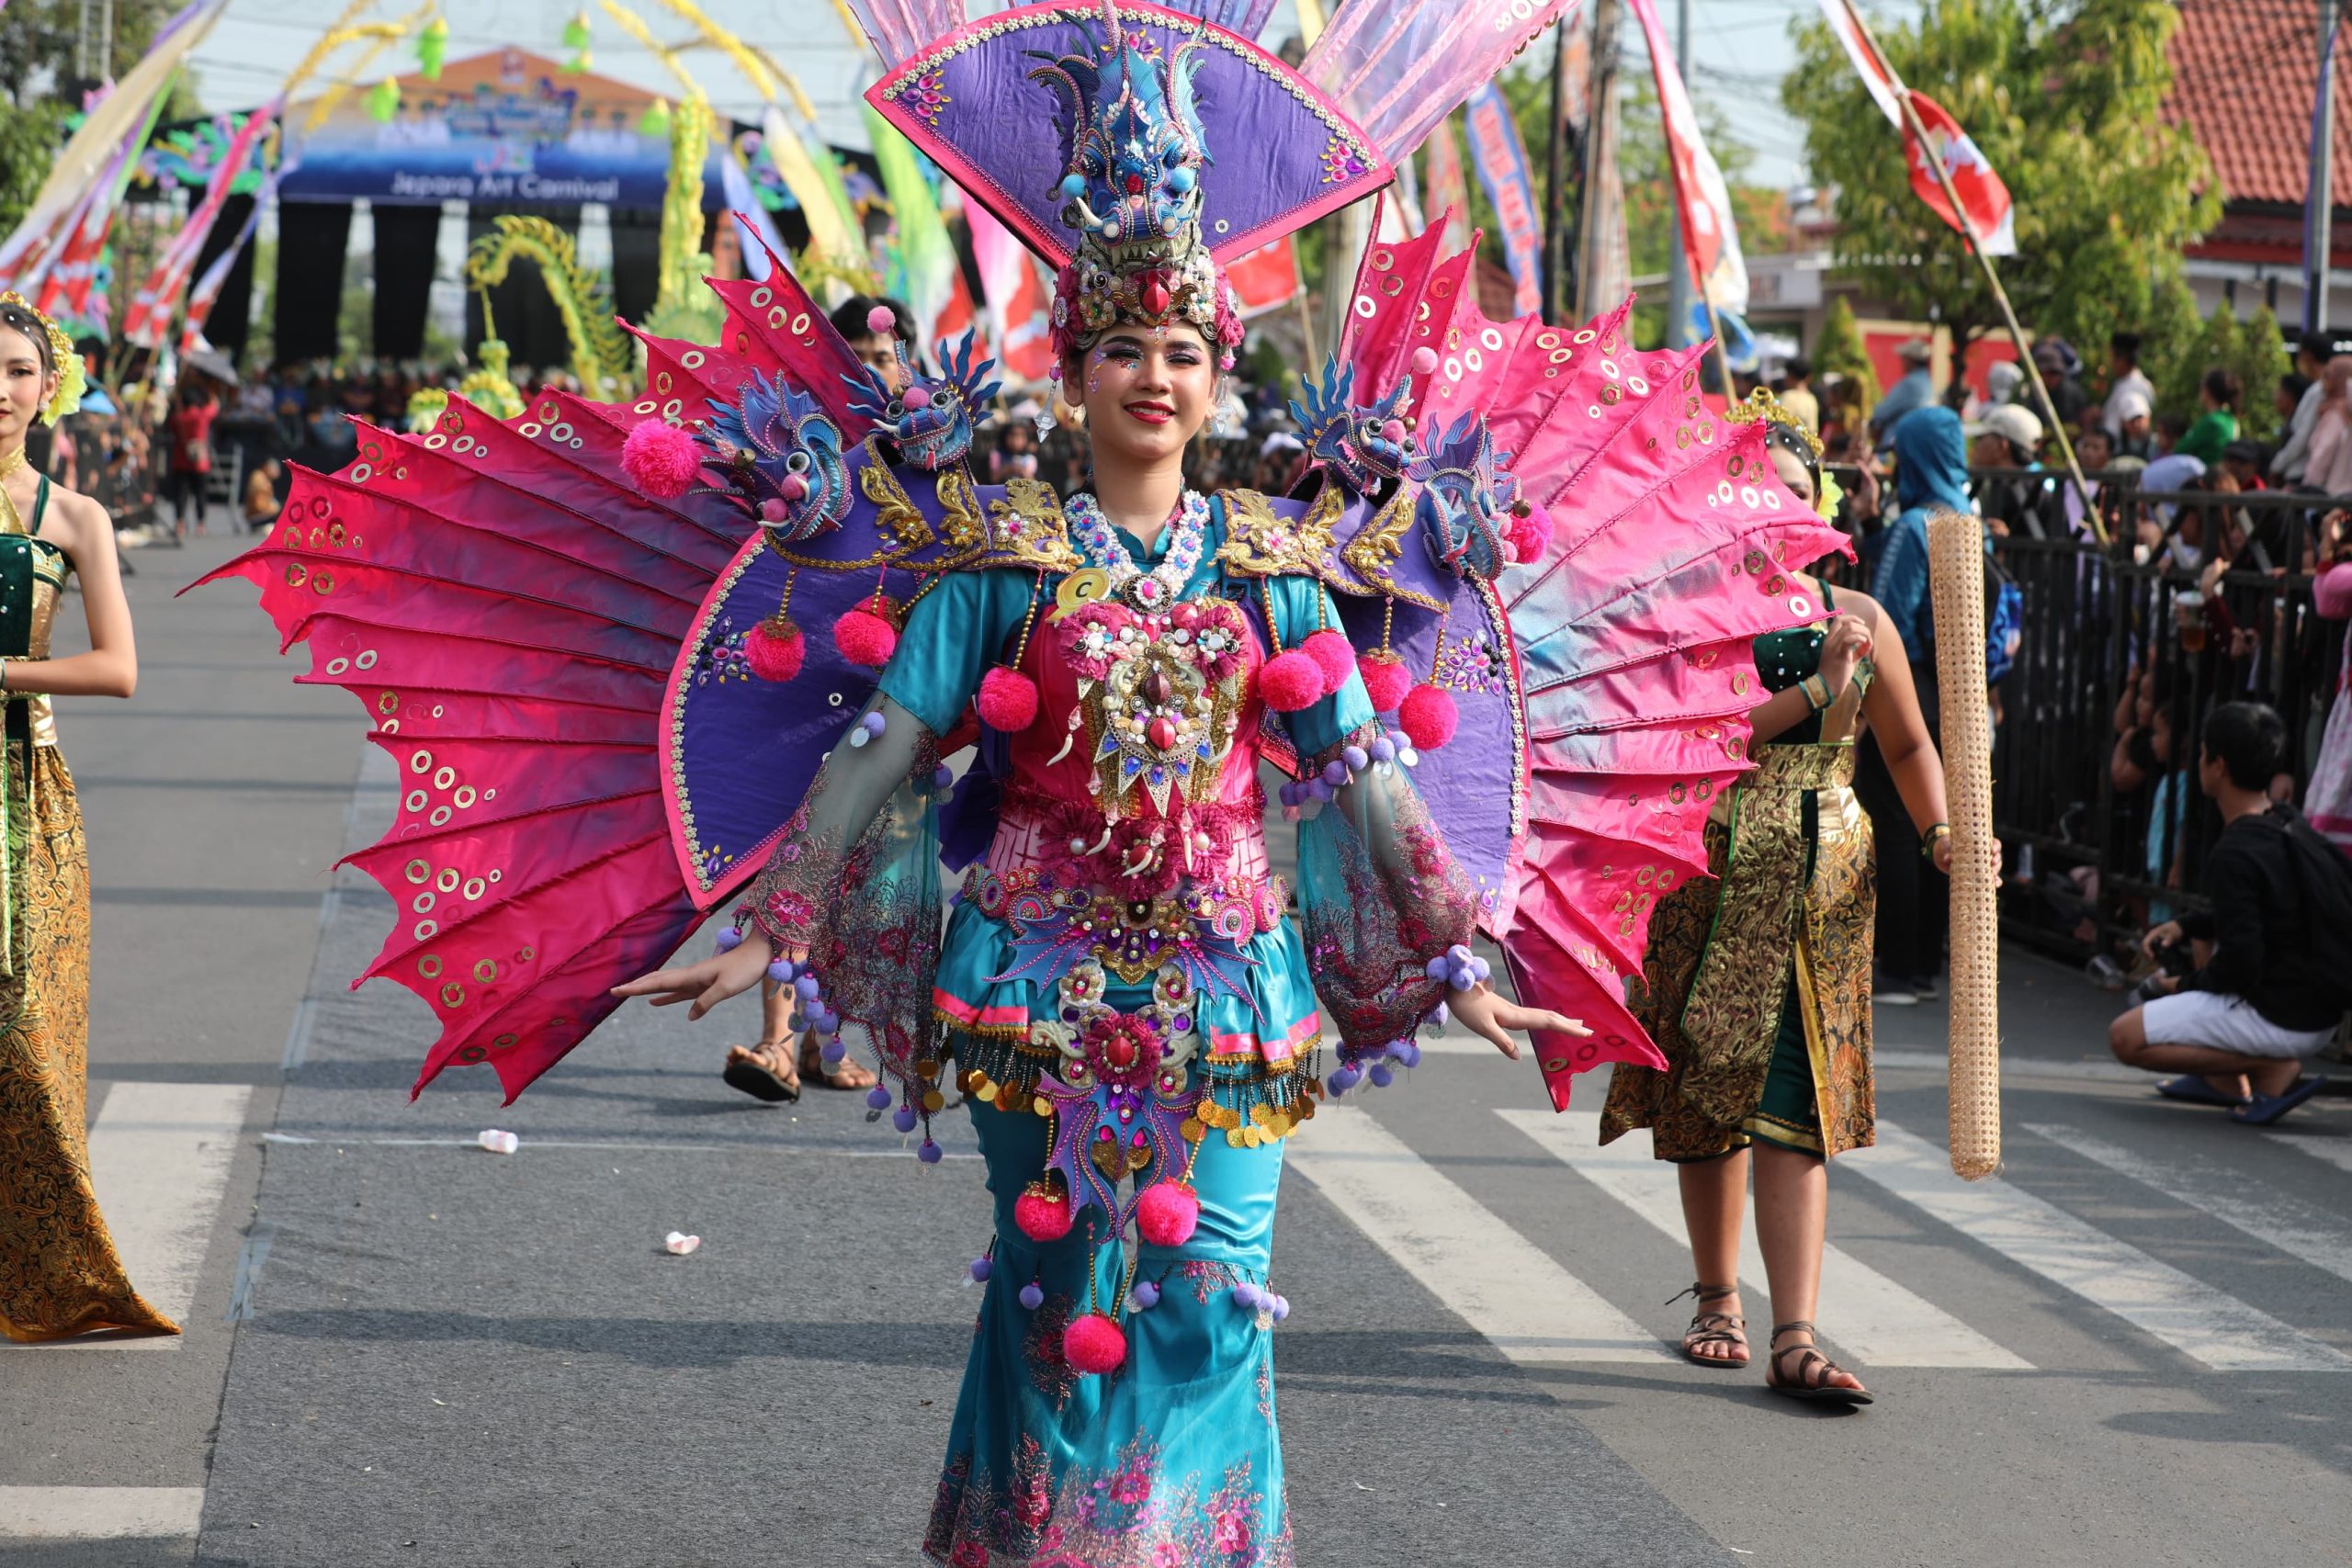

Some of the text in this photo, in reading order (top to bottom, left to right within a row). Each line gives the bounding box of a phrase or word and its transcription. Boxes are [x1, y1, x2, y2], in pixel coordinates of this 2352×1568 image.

[392, 171, 618, 200] Jepara Art Carnival
[1075, 581, 1092, 598] C
